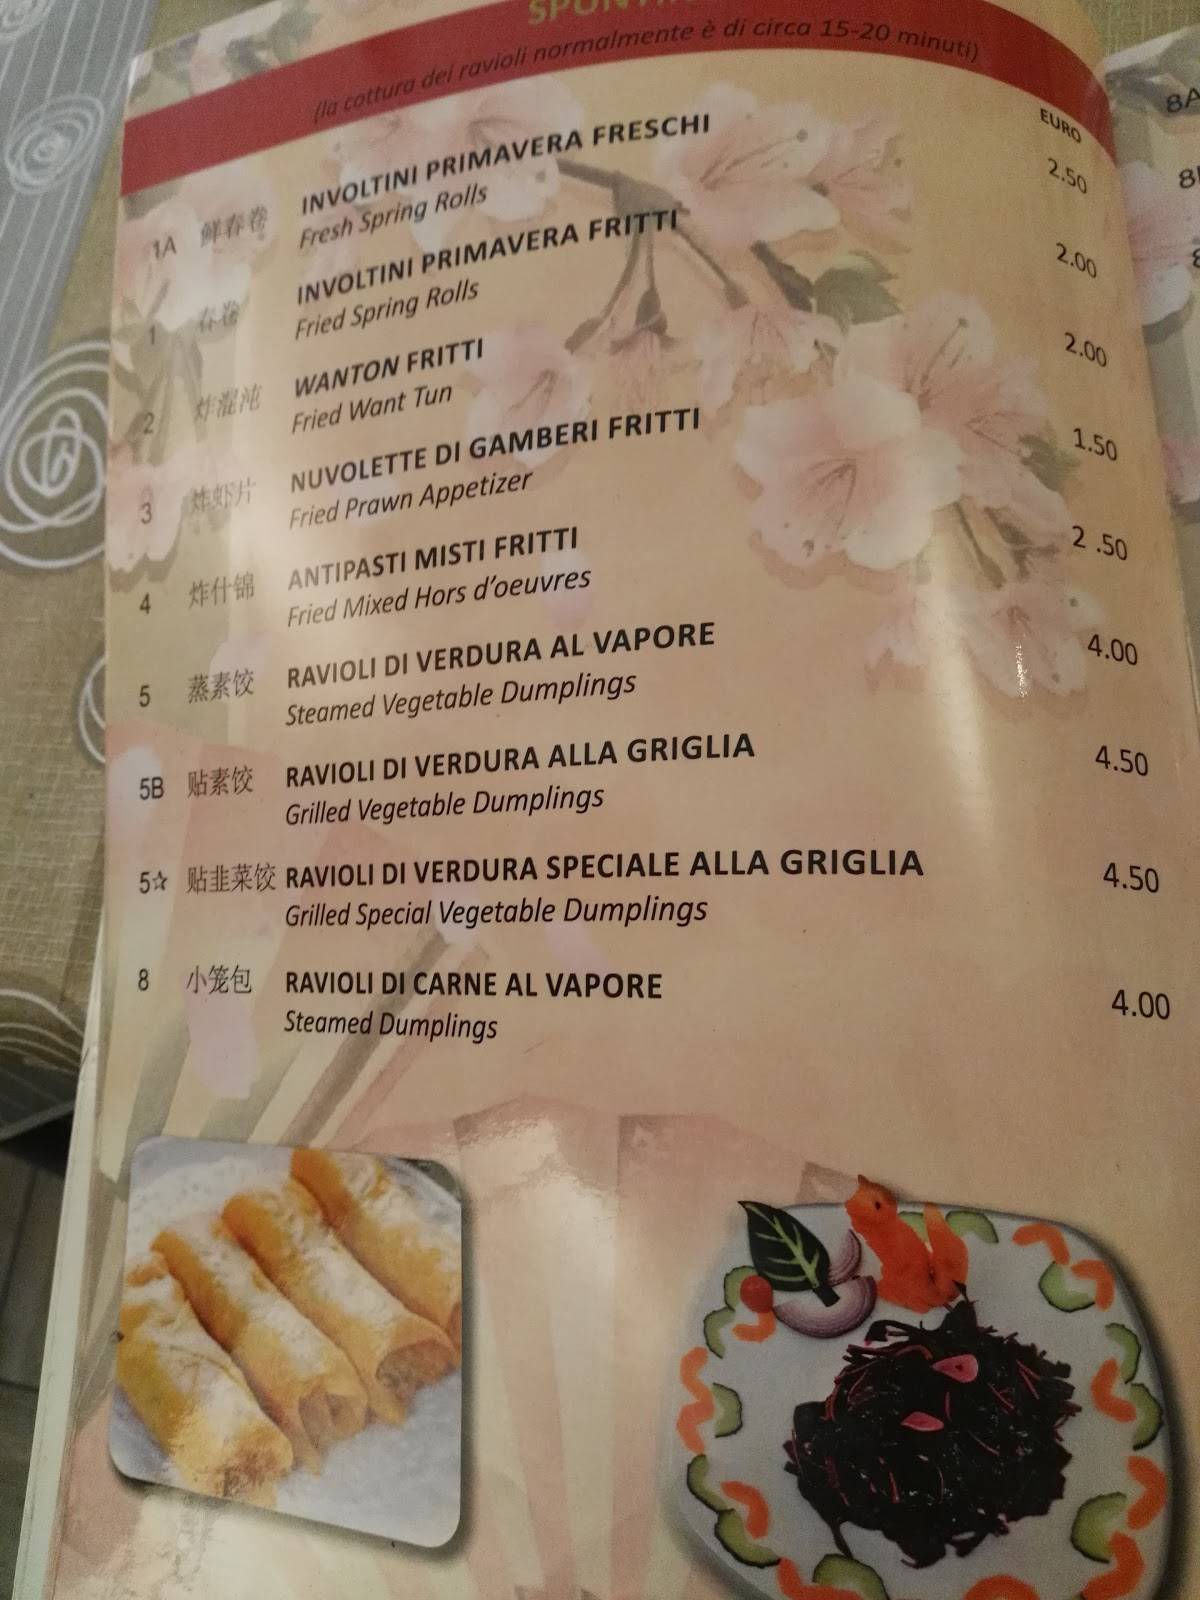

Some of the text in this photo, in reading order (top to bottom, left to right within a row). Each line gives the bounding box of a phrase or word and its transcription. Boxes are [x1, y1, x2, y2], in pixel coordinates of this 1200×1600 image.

[344, 77, 416, 111] cottura
[421, 67, 453, 89] dei
[459, 46, 528, 83] ravioli
[532, 24, 694, 63] normalmente
[702, 19, 716, 39] è
[723, 17, 748, 38] di
[752, 19, 812, 37] circa
[820, 19, 891, 42] 15-20
[897, 29, 980, 63] minuti)
[1039, 107, 1082, 144] EURO
[301, 113, 711, 215] INVOLTINI PRIMAVERA FRESCHI
[1047, 157, 1088, 195] 2.50
[200, 205, 268, 248] 鲜春卷
[299, 182, 489, 250] Fresh Spring Rolls
[153, 235, 177, 260] 1A
[297, 209, 679, 306] INVOLTINI PRIMAVERA FRITTI
[1055, 242, 1097, 280] 2.00
[199, 300, 240, 334] 春卷
[294, 279, 480, 341] Fried Spring Rolls
[150, 325, 156, 346] 1
[1064, 331, 1107, 368] 2.00
[294, 338, 484, 399] WANTON FRITTI
[143, 412, 155, 435] 2
[291, 383, 453, 436] Fried Want Tun
[291, 407, 701, 494] NUVOLETTE DI GAMBERI FRITTI
[1073, 427, 1118, 462] 1.50
[140, 502, 153, 525] 3
[191, 478, 257, 513] 炸虾片
[289, 469, 534, 530] Fried Prawn Appetizer
[288, 526, 579, 592] ANTIPASTI MISTI FRITTI
[139, 592, 152, 615] 4
[188, 571, 256, 609] 炸什锦
[287, 602, 337, 628] Fried
[343, 588, 408, 619] Mixed
[414, 581, 467, 608] Hors
[287, 621, 716, 690] RAVIOLI DI VERDURA AL VAPORE
[1087, 634, 1138, 666] 4.00
[139, 684, 151, 708] 5
[187, 667, 255, 704] 蒸素饺
[285, 670, 637, 727] Steamed Vegetable Dumplings
[286, 732, 756, 788] RAVIOLI DI VERDURA ALLA GRIGLIA
[1095, 745, 1149, 777] 4.50
[139, 776, 165, 801] 5B
[187, 765, 254, 799] 贴素饺
[285, 783, 605, 826] Grilled Vegetable Dumplings
[186, 862, 276, 894] 贴韭菜饺
[286, 849, 925, 889] RAVIOLI DI VERDURA SPECIALE ALLA GRIGLIA
[1103, 862, 1159, 894] 4.50
[285, 894, 708, 930] Grilled Special Vegetable Dumplings
[138, 968, 149, 992] 8
[186, 965, 252, 995] 小笼包
[286, 970, 663, 1000] RAVIOLI DI CARNE AL VAPORE
[1111, 989, 1170, 1020] 4.00
[284, 1009, 499, 1044] Steamed Dumplings
